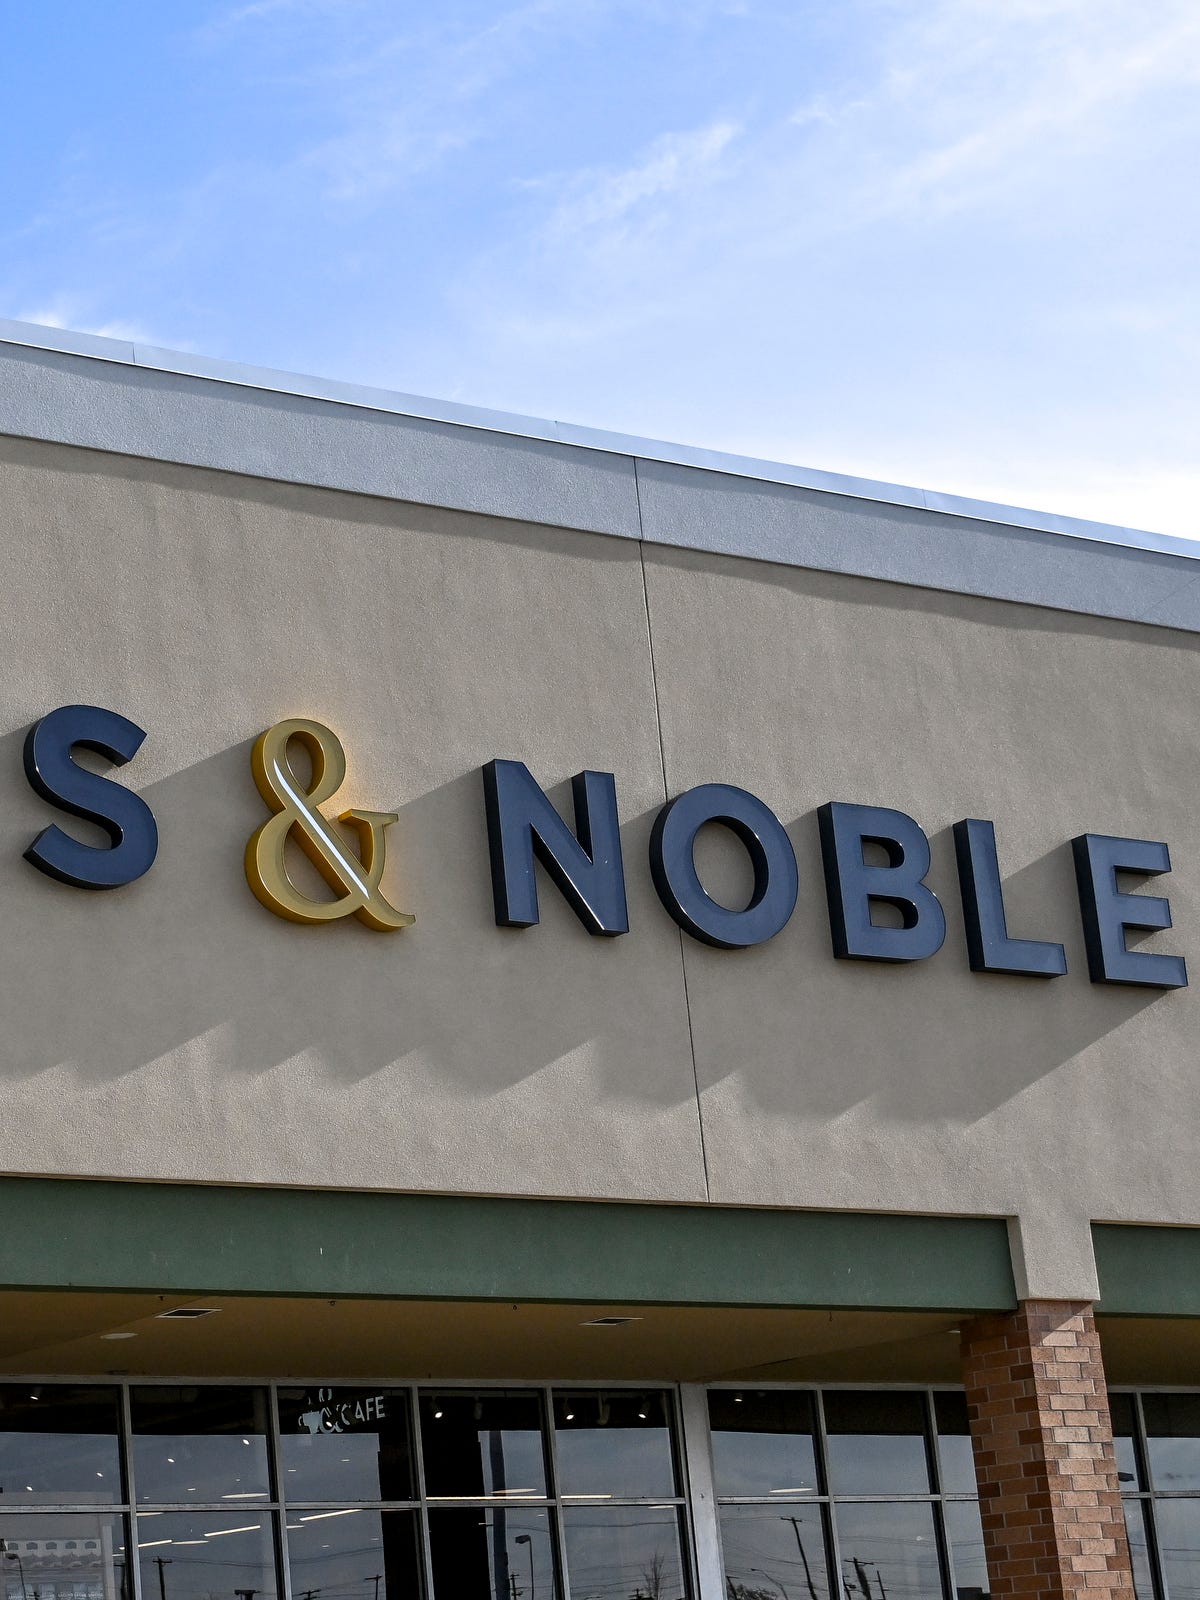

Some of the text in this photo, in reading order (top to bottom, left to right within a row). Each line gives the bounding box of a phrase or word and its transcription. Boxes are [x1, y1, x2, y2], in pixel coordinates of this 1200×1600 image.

[244, 718, 416, 933] &
[482, 758, 1188, 990] NOBLE
[341, 1396, 385, 1425] CAFE
